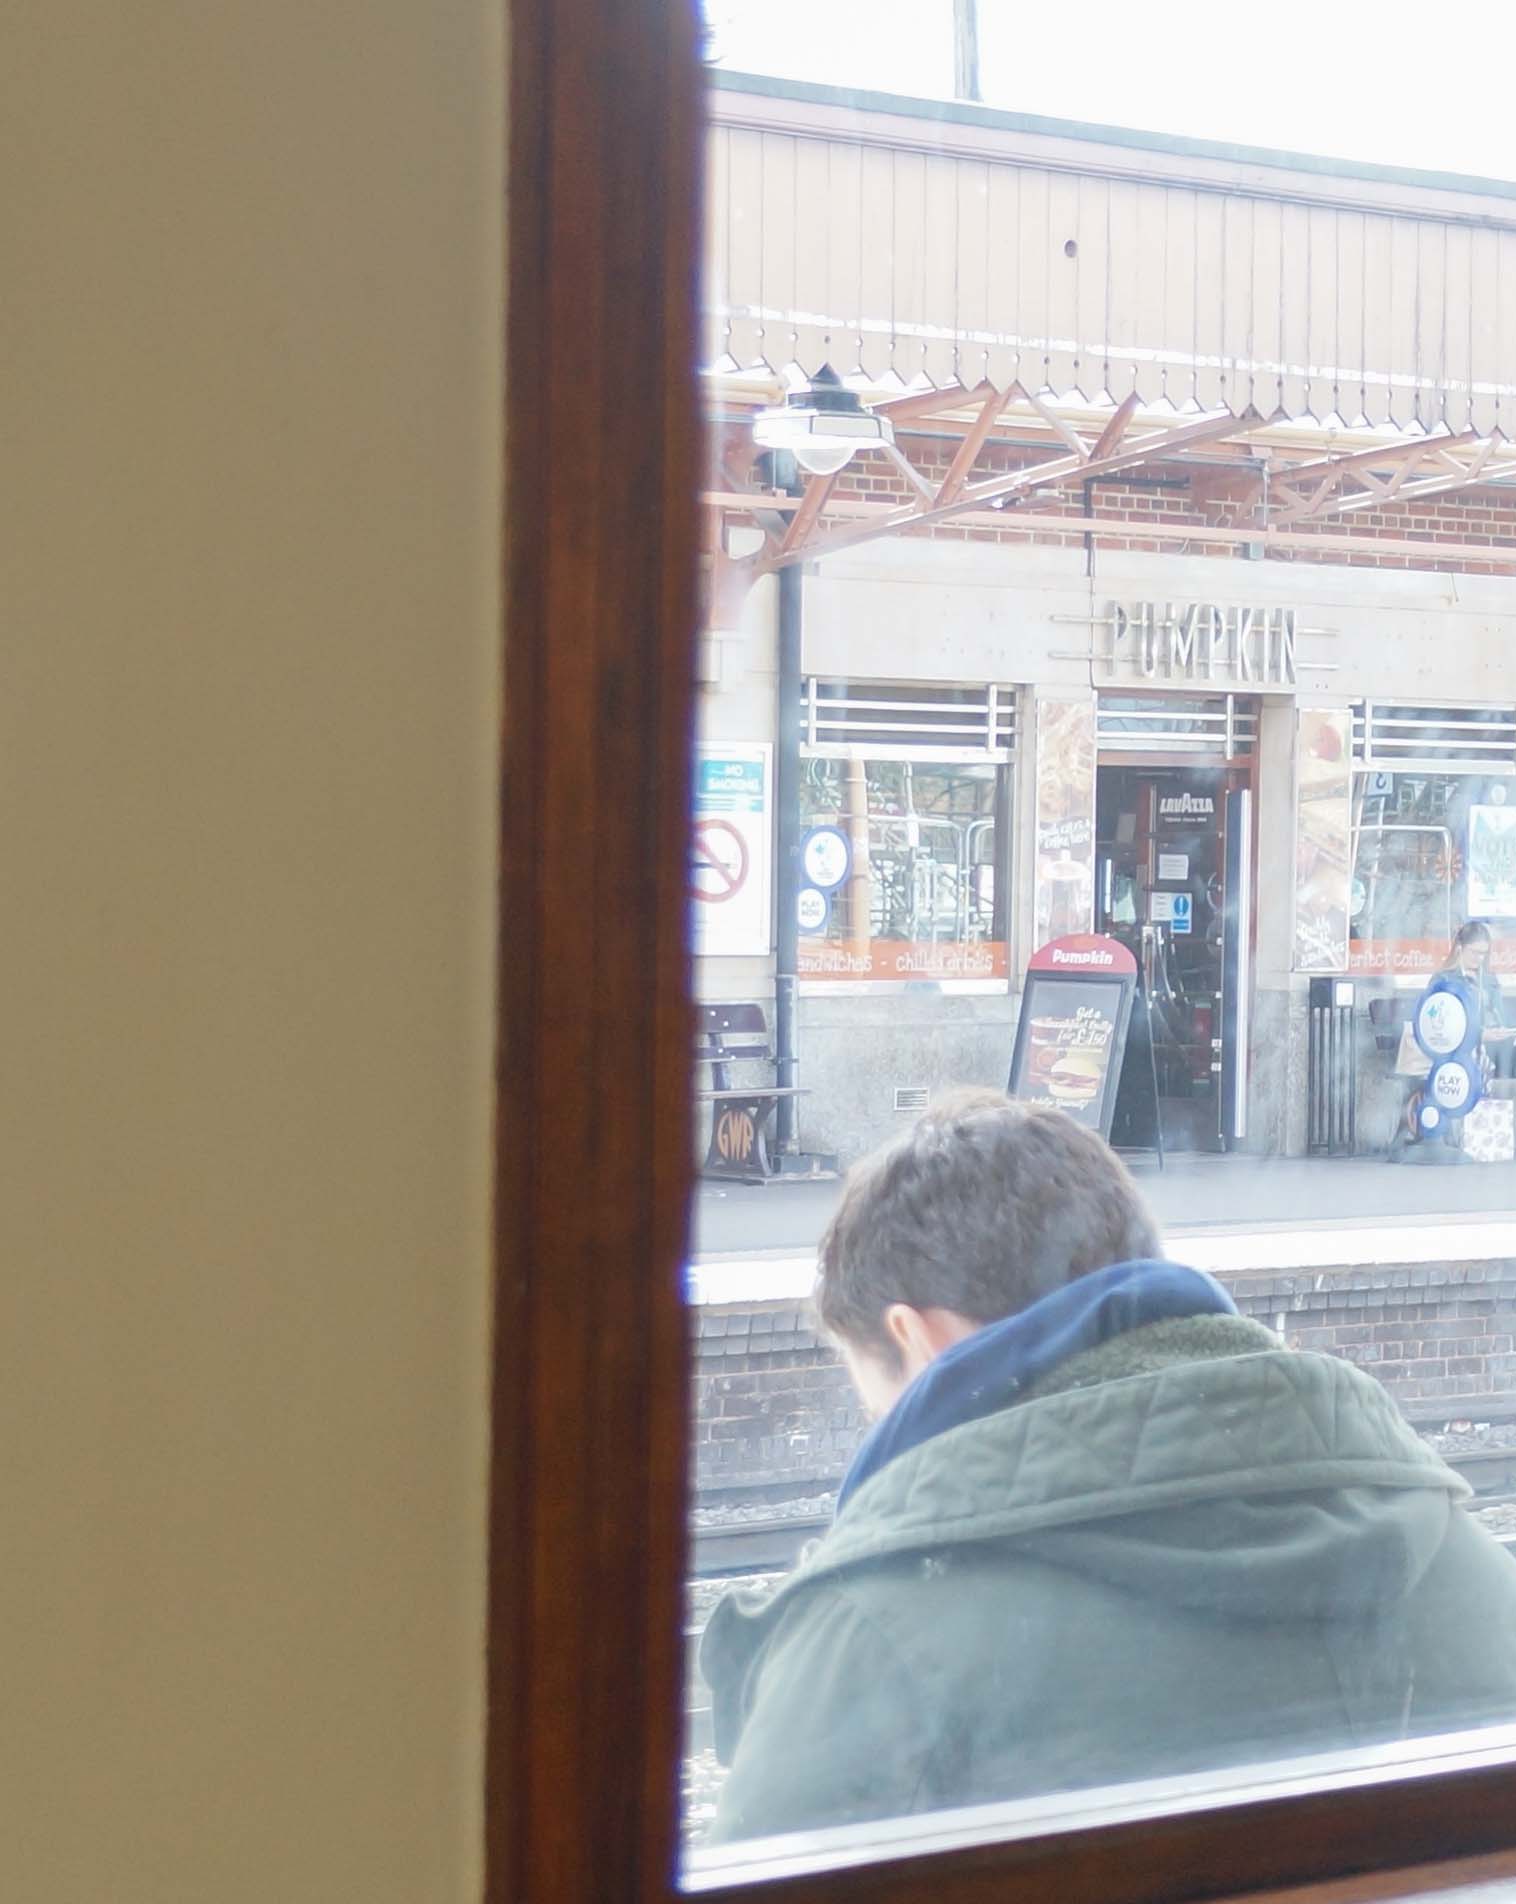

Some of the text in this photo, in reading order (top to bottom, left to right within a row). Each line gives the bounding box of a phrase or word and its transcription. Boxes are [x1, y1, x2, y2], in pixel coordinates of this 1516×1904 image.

[1104, 600, 1296, 684] PUMPKIN
[1160, 793, 1214, 813] LAVAZZA
[1053, 949, 1113, 965] Pumpkin
[717, 1109, 754, 1161] GWR
